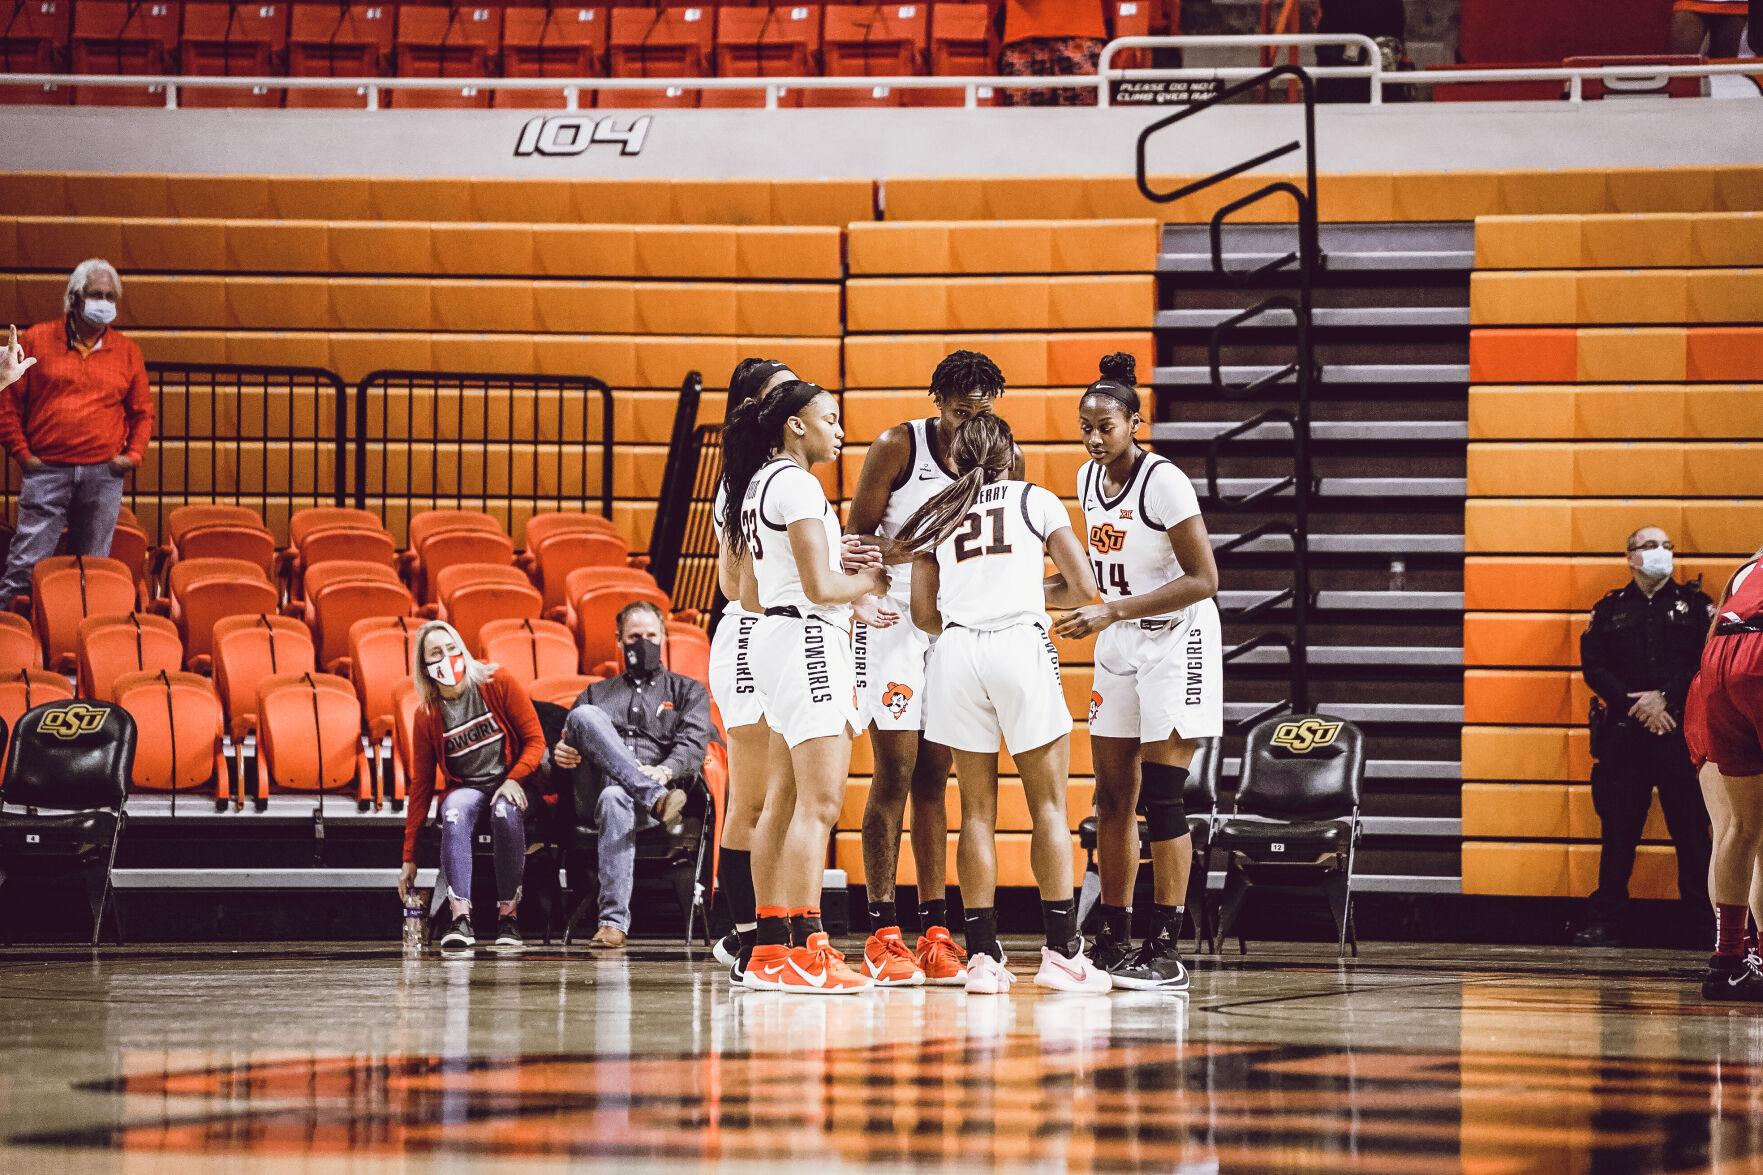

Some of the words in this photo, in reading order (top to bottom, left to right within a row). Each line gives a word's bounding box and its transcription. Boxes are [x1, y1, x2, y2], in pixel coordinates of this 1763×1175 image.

[1117, 92, 1154, 101] CLIMB
[1120, 83, 1166, 91] PLEASE
[1169, 83, 1188, 91] DO
[1190, 82, 1217, 91] NOT
[513, 115, 653, 156] 104
[976, 486, 1008, 505] ERRY
[954, 507, 1012, 563] 21
[1090, 523, 1127, 554] OSU
[1095, 560, 1132, 595] 14
[804, 625, 832, 703] COWGIRLS
[855, 621, 867, 688] OWGIRLS
[1185, 629, 1203, 706] COWGIRLS
[37, 704, 110, 739] OSU
[1270, 719, 1344, 753] OSU
